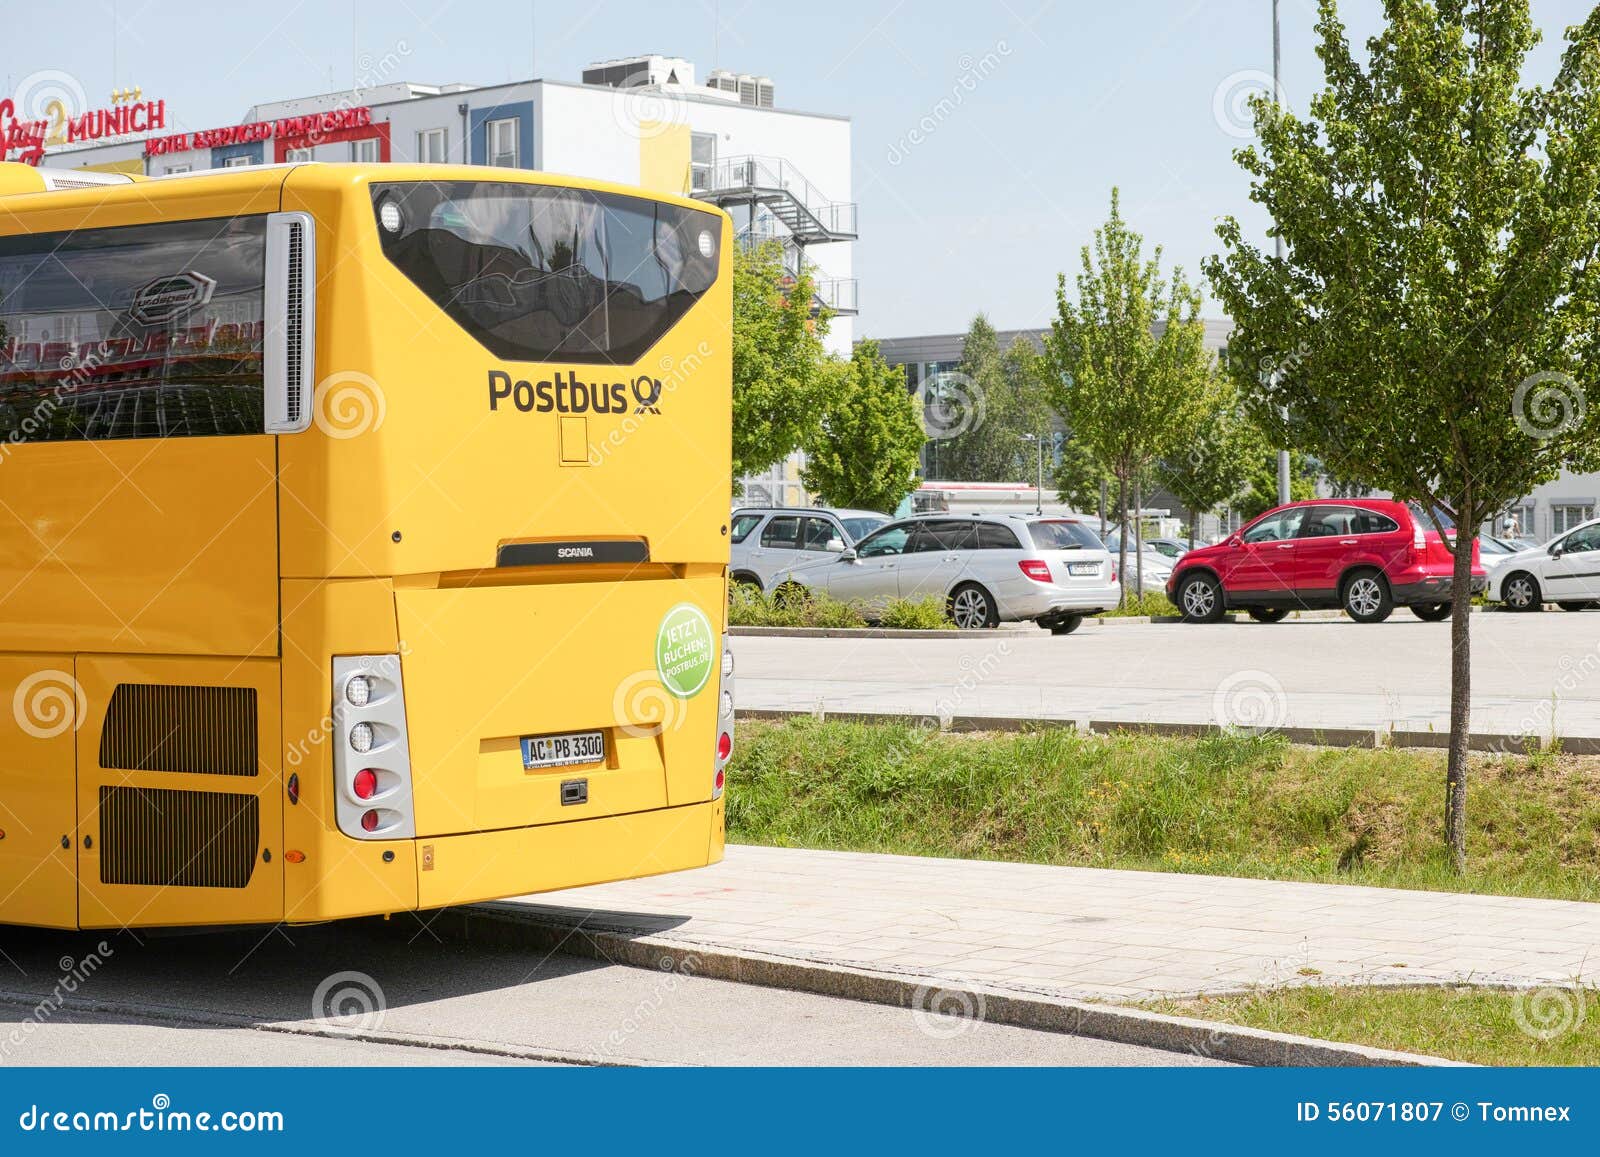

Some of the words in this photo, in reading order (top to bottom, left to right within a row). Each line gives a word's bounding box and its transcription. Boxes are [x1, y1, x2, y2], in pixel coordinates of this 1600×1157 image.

[45, 100, 67, 146] 2
[67, 99, 165, 143] MUNICH
[145, 134, 191, 157] HOTEL
[488, 370, 628, 414] Postbus
[557, 547, 594, 558] SCANIA
[667, 618, 697, 649] JETZT
[664, 637, 707, 665] BUCHEN:
[666, 652, 712, 678] POSTBUS.DE
[530, 741, 546, 761] AC
[554, 739, 571, 758] PB
[572, 735, 602, 757] 3300
